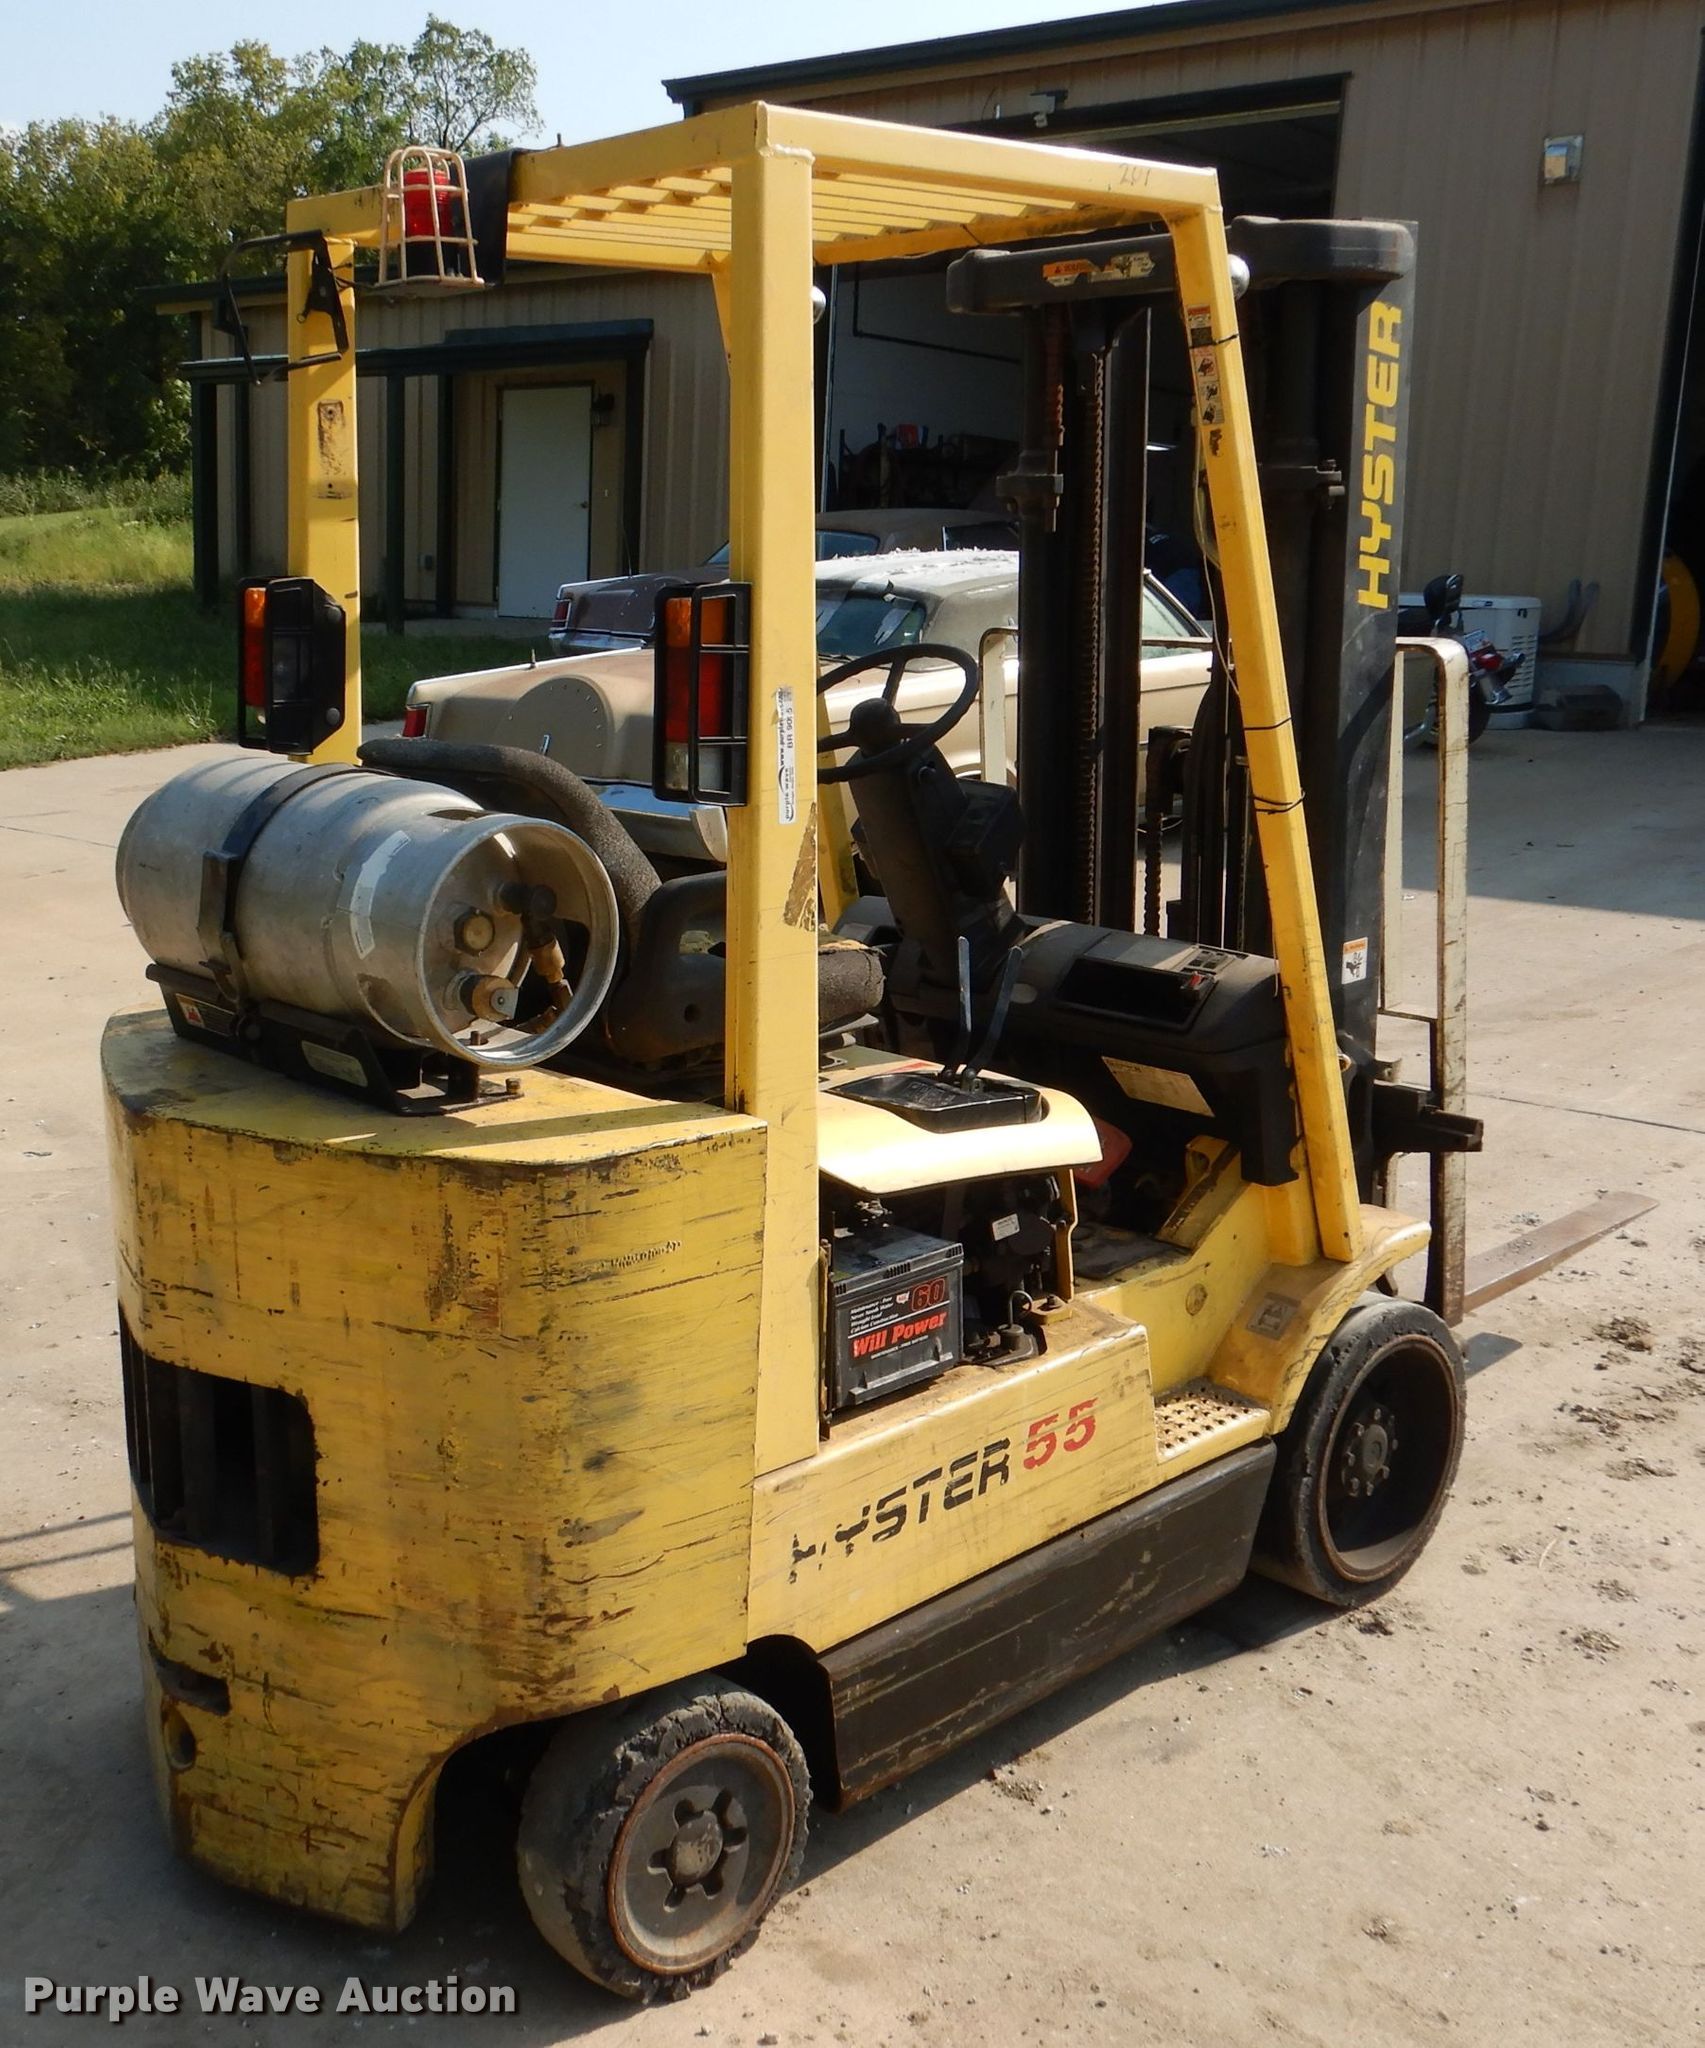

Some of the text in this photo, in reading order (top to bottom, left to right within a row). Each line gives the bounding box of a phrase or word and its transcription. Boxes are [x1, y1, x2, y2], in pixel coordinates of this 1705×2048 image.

[1358, 299, 1402, 609] HYSTER
[911, 1277, 946, 1312] 60
[853, 1329, 888, 1358] Will
[891, 1312, 947, 1344] Power
[1023, 1396, 1098, 1470] 55
